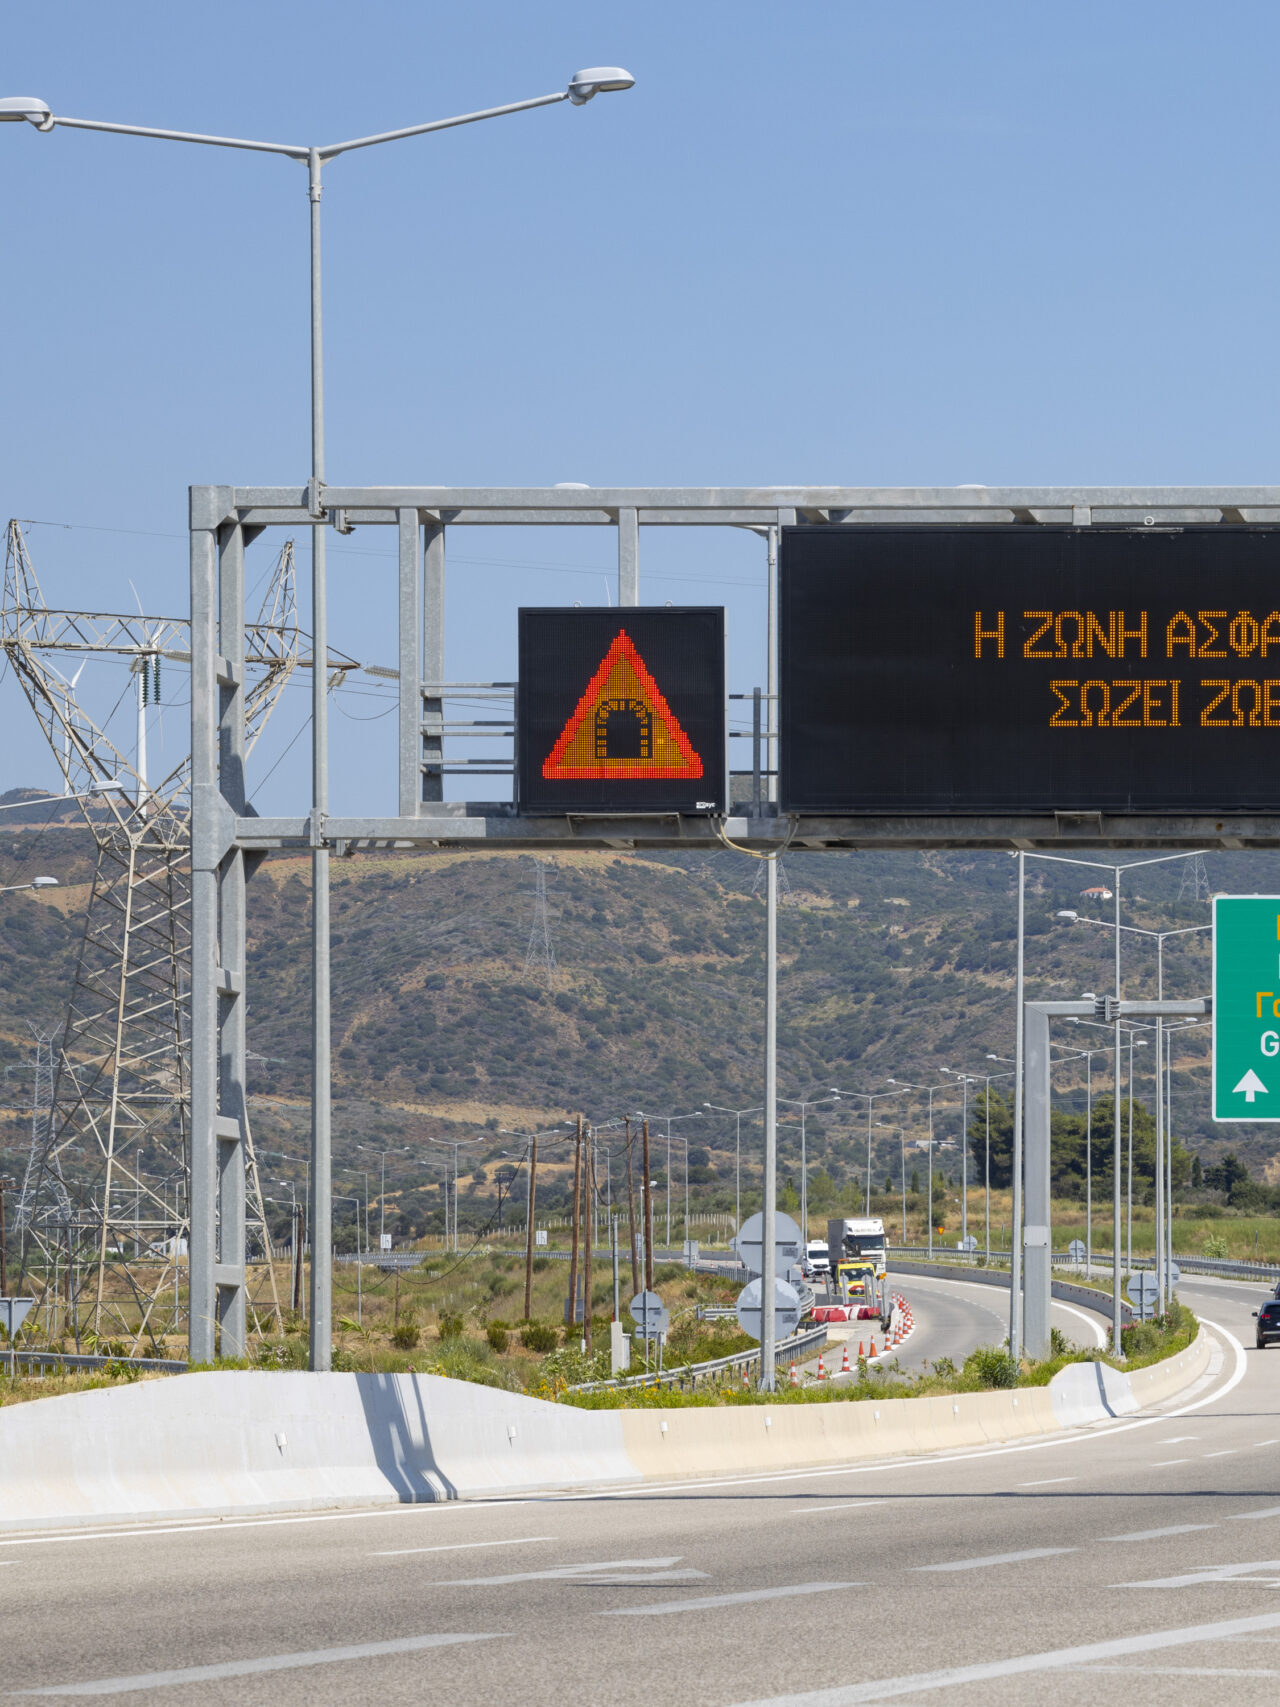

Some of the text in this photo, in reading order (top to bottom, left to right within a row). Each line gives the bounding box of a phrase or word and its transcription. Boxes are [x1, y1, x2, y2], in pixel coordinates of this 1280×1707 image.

[975, 611, 1005, 659] Η
[1023, 610, 1148, 658] ΖΩΝΗ
[1049, 679, 1182, 727] ΣΩΖΕΙ
